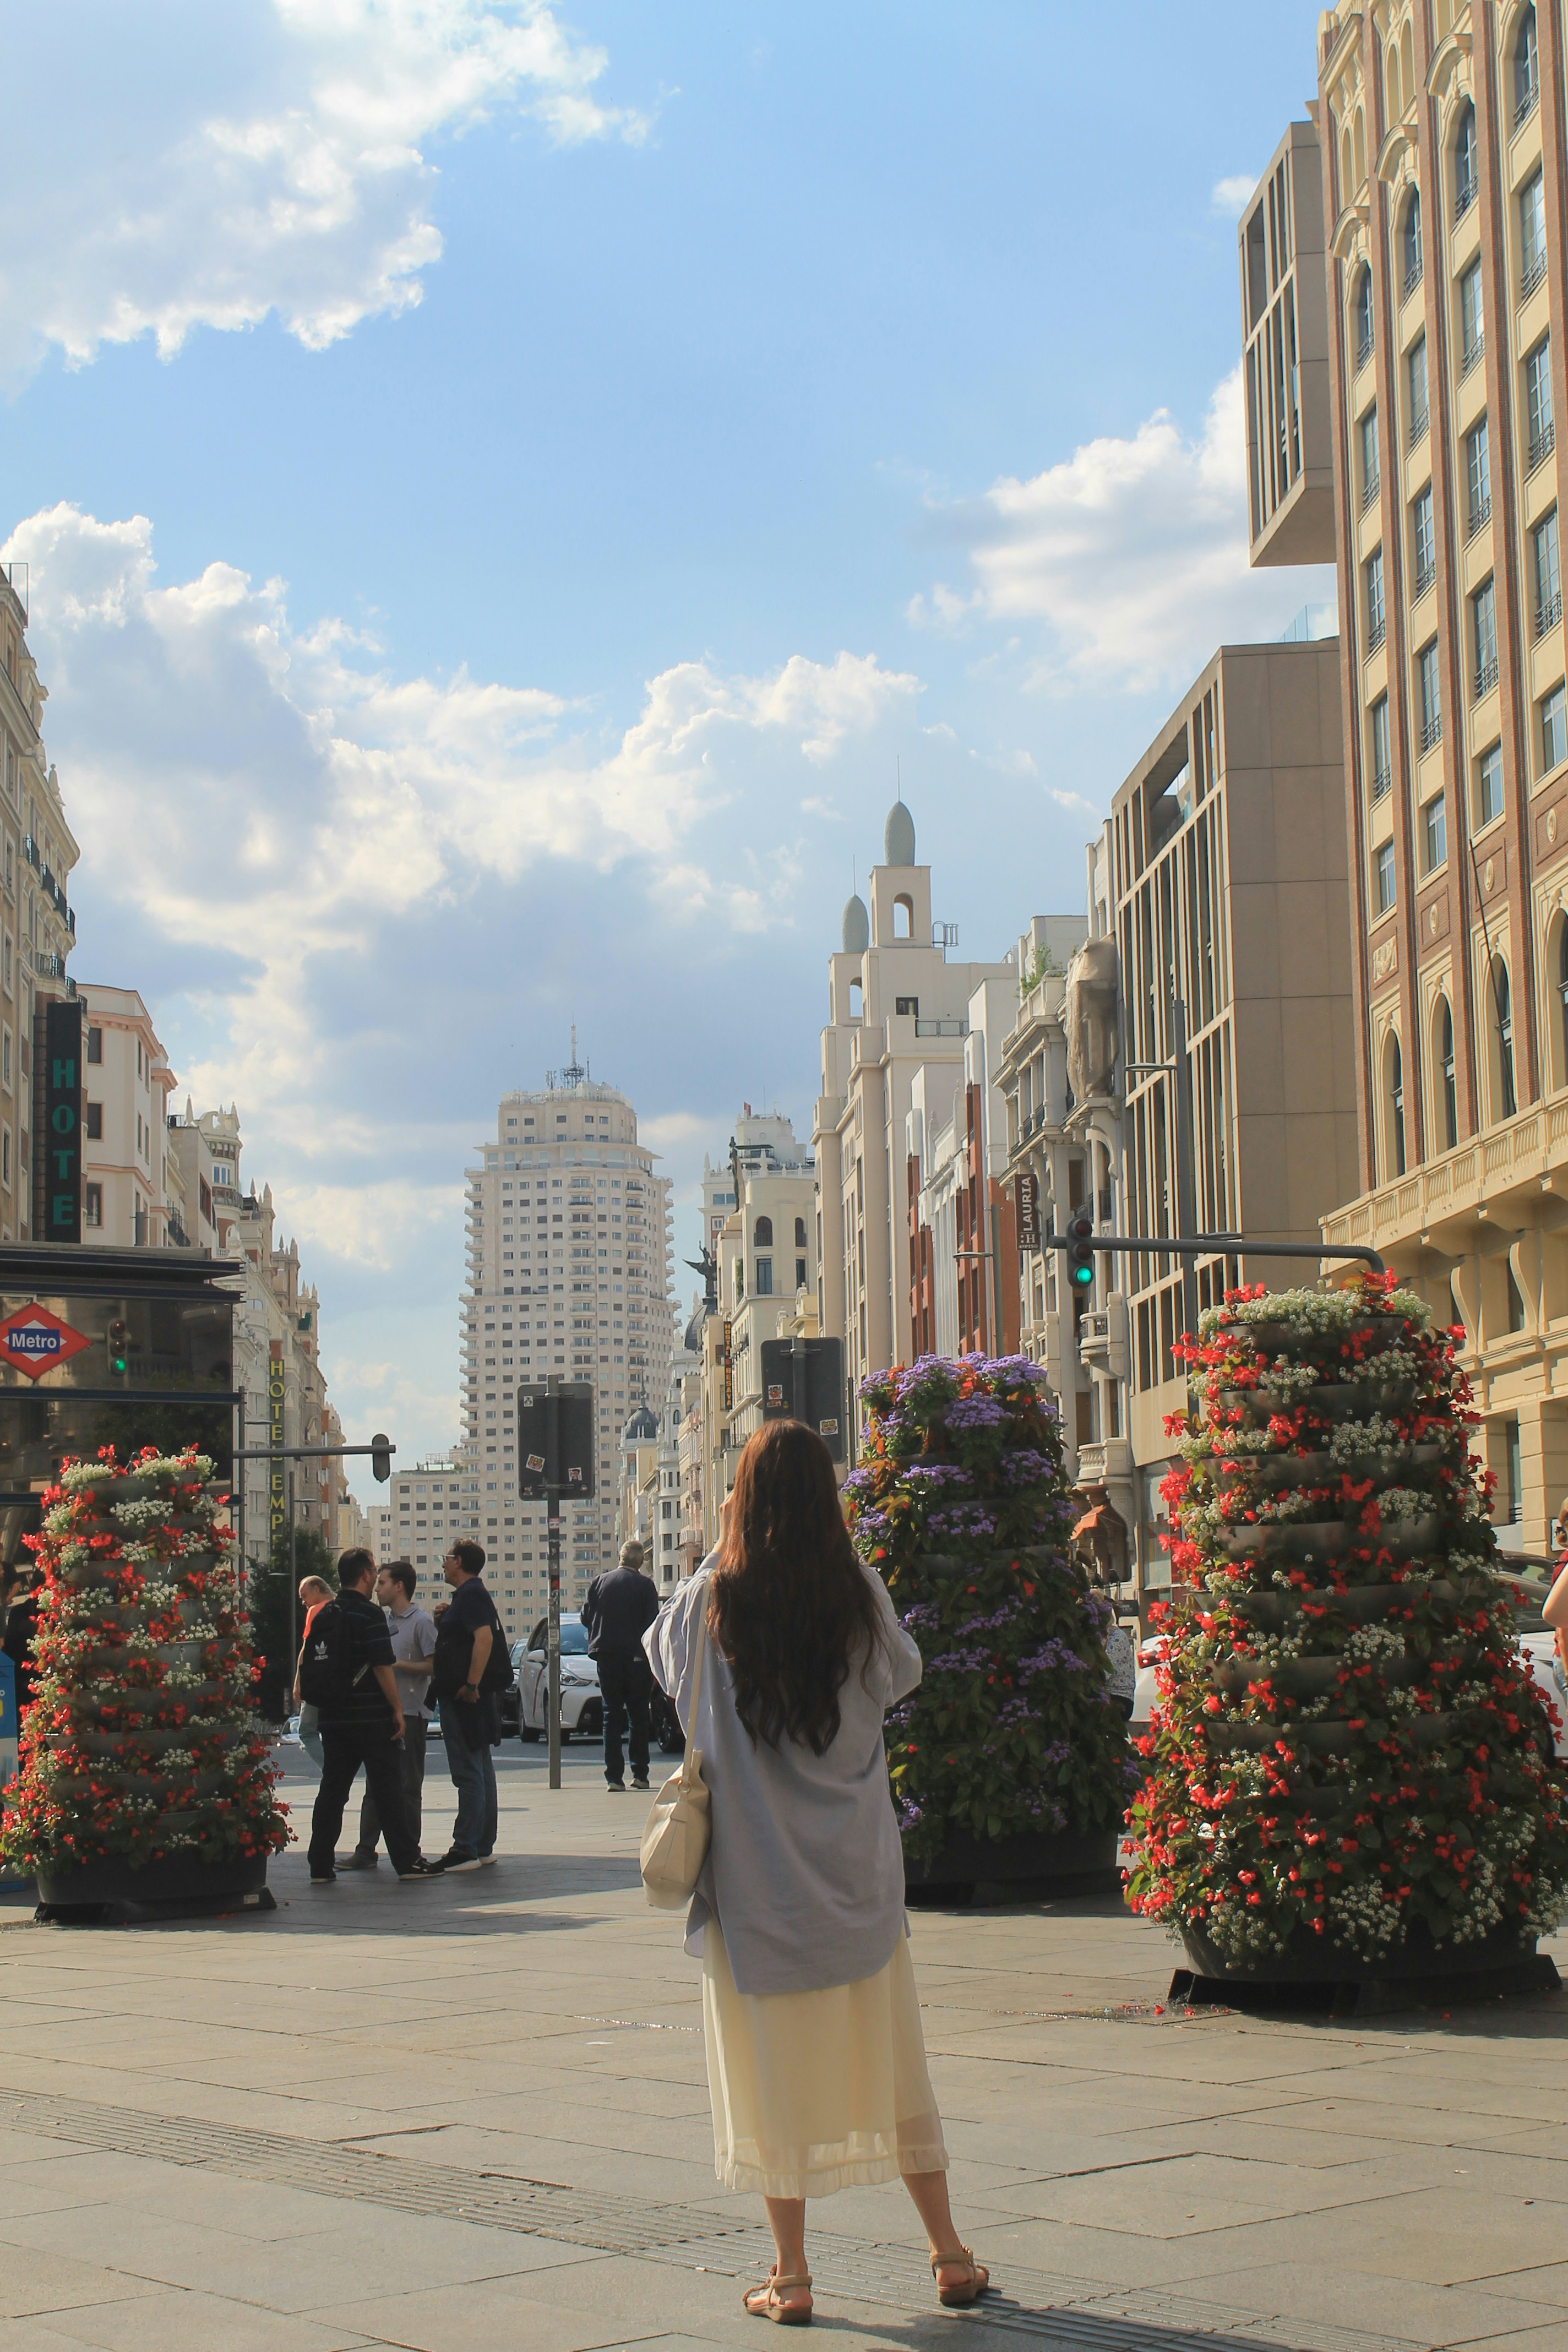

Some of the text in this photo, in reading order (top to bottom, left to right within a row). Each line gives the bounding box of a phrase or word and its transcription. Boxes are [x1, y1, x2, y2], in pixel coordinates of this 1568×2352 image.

[52, 1059, 75, 1225] HOTE
[1021, 1177, 1032, 1231] LAURIA
[12, 1333, 57, 1348] Metro
